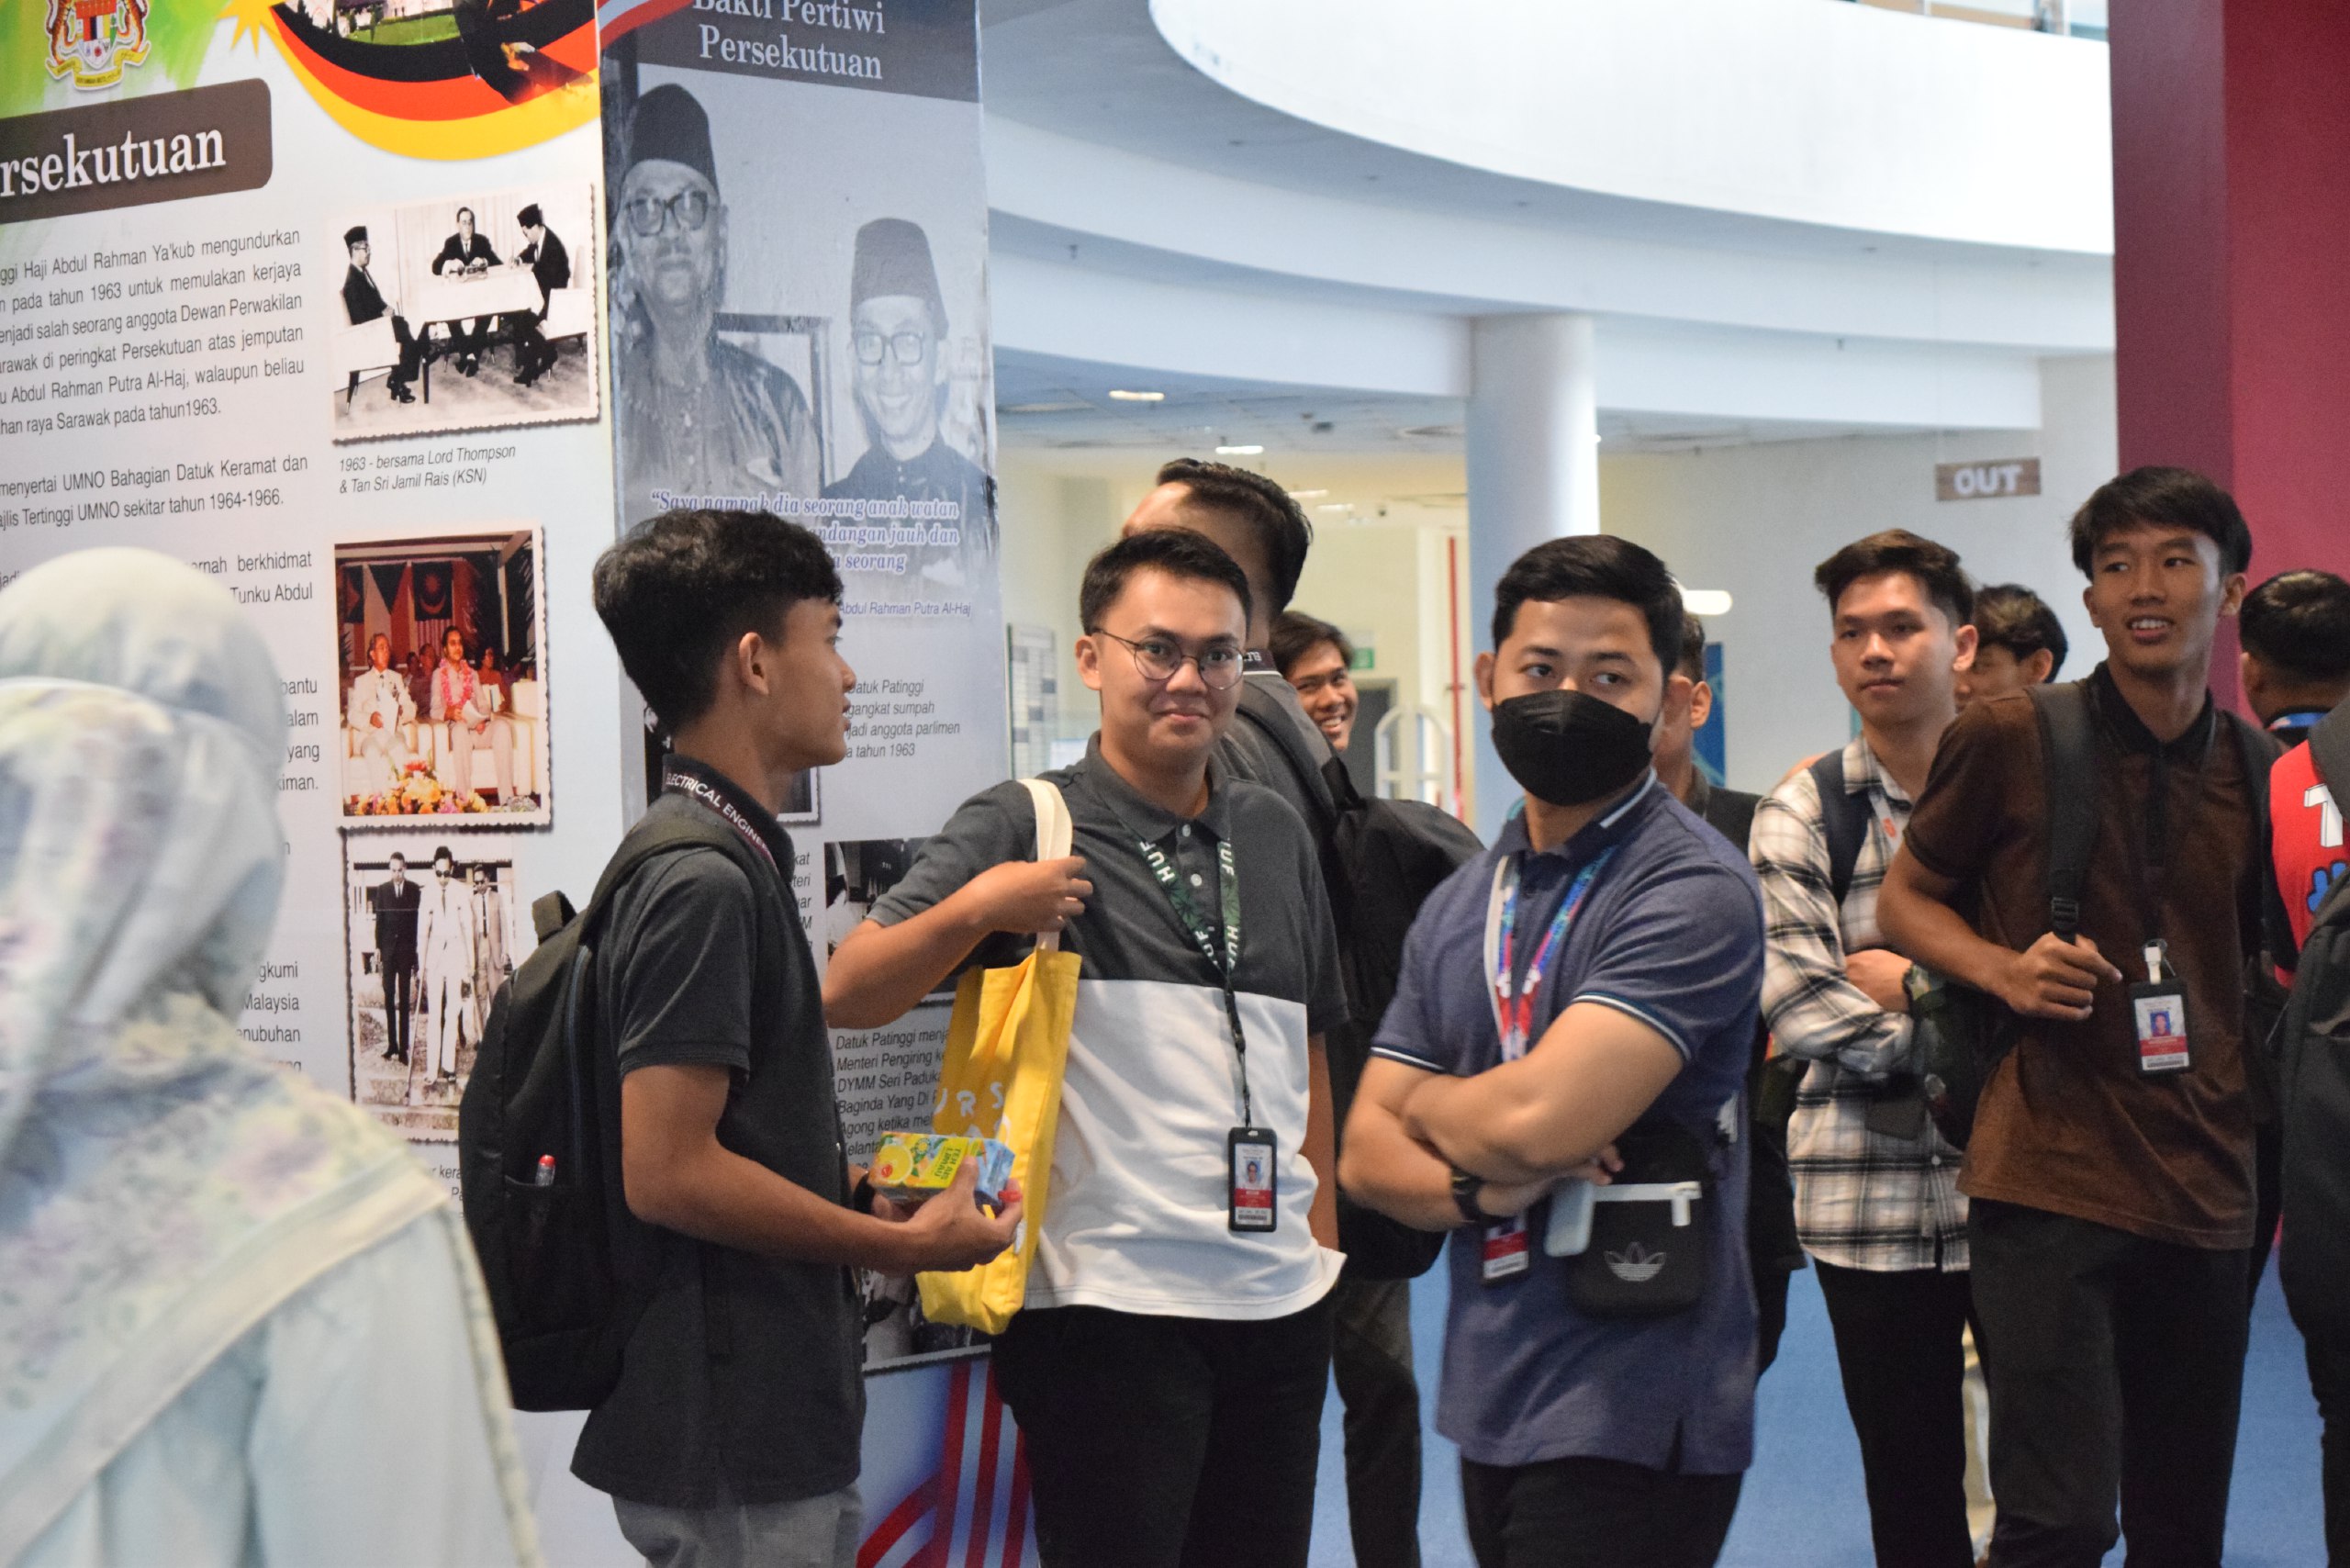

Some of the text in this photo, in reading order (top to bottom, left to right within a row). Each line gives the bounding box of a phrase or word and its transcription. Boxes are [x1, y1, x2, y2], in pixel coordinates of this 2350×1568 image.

[780, 0, 885, 34] Pertiwi
[699, 24, 883, 79] Persekutuan
[0, 129, 226, 197] rsekutuan
[24, 259, 47, 281] Haji
[52, 253, 87, 274] Abdul
[94, 251, 147, 269] Rahman
[152, 241, 195, 262] Ya'kub
[201, 229, 300, 256] mengundurkan
[13, 292, 43, 314] pada
[50, 288, 84, 307] tahun
[91, 282, 122, 300] 1963
[129, 276, 163, 297] untuk
[171, 268, 245, 291] memulakan
[252, 262, 301, 284] kerjaya
[37, 319, 69, 339] salah
[73, 316, 122, 335] seorang
[126, 308, 177, 330] anggota
[181, 304, 226, 322] Dewan
[229, 293, 302, 317] Perwakilan
[43, 352, 54, 369] di
[60, 346, 117, 371] peringkat
[122, 338, 202, 360] Persekutuan
[208, 333, 236, 351] atas
[241, 326, 303, 351] jemputan
[11, 384, 46, 403] Abdul
[52, 380, 103, 398] Rahman
[109, 375, 142, 393] Putra
[147, 368, 189, 389] Al-Haj,
[195, 364, 258, 384] walaupun
[264, 357, 305, 376] beliau
[26, 417, 53, 435] raya
[57, 409, 111, 430] Sarawak
[114, 405, 146, 428] pada
[340, 456, 366, 472] 1963
[376, 453, 425, 469] bersama
[428, 448, 453, 465] Lord
[456, 445, 516, 463] Thompson
[62, 470, 105, 491] UMNO
[111, 466, 171, 488] Bahagian
[176, 462, 215, 481] Datuk
[220, 456, 276, 476] Keramat
[283, 454, 308, 472] dan
[339, 467, 487, 494] & Tan Sri Jamil Rais (KSN)
[1953, 465, 2024, 495] OUT
[22, 505, 74, 528] Tertinggi
[78, 500, 120, 521] UMNO
[124, 498, 166, 517] sekitar
[169, 496, 206, 513] tahun
[209, 487, 284, 510] 1964-1966.
[773, 494, 799, 514] dia
[804, 498, 864, 517] seorang
[867, 497, 908, 517] anak
[912, 498, 958, 517] watan
[811, 522, 958, 546] ndangan jauh dan
[238, 551, 312, 572] berkhidmat
[845, 554, 905, 572] seorang
[229, 581, 313, 604] Tunku Abdul
[869, 601, 911, 615] Rahman
[913, 601, 939, 615] Putra
[942, 601, 971, 617] Al-Haj
[882, 679, 924, 697] Patinggi
[893, 700, 934, 717] sumpah
[870, 722, 912, 739] anggota
[915, 721, 960, 738] parlimen
[287, 745, 319, 763] yang
[856, 744, 886, 758] tahun
[890, 742, 915, 756] 1963
[836, 1034, 868, 1050] Datuk
[872, 1030, 916, 1047] Patinggi
[836, 1056, 878, 1071] Menteri
[881, 1051, 932, 1069] Pengiring
[837, 1075, 876, 1093] DYMM
[878, 1073, 901, 1089] Seri
[838, 1097, 883, 1116] Baginda
[887, 1093, 915, 1113] Yang
[917, 1091, 929, 1107] Di
[878, 1115, 910, 1133] ketika
